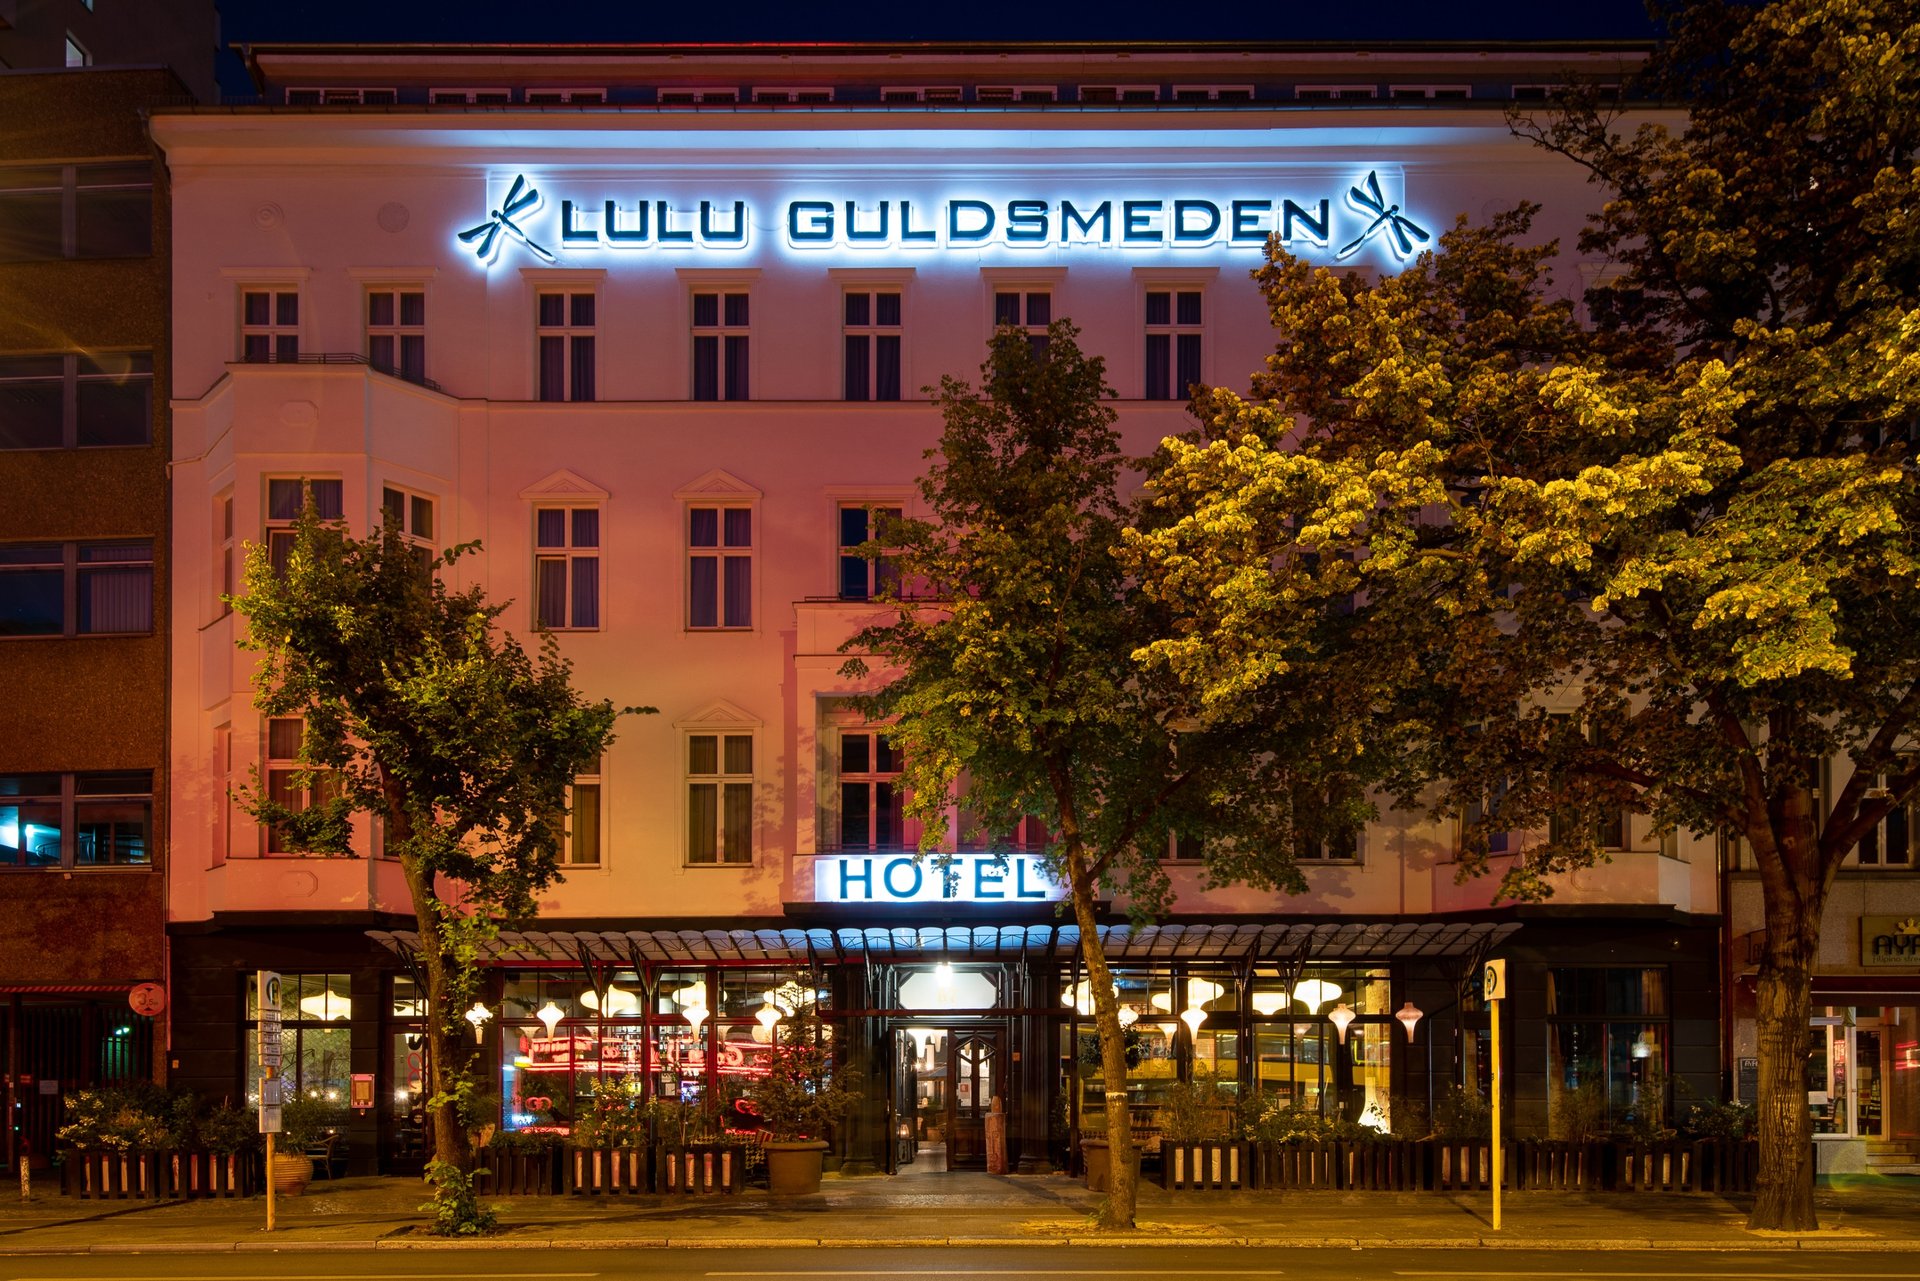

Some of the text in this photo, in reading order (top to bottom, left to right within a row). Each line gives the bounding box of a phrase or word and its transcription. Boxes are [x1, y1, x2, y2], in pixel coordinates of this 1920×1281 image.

[561, 199, 1329, 241] LULU GULDSMEDEN
[839, 858, 1046, 898] HOTEL
